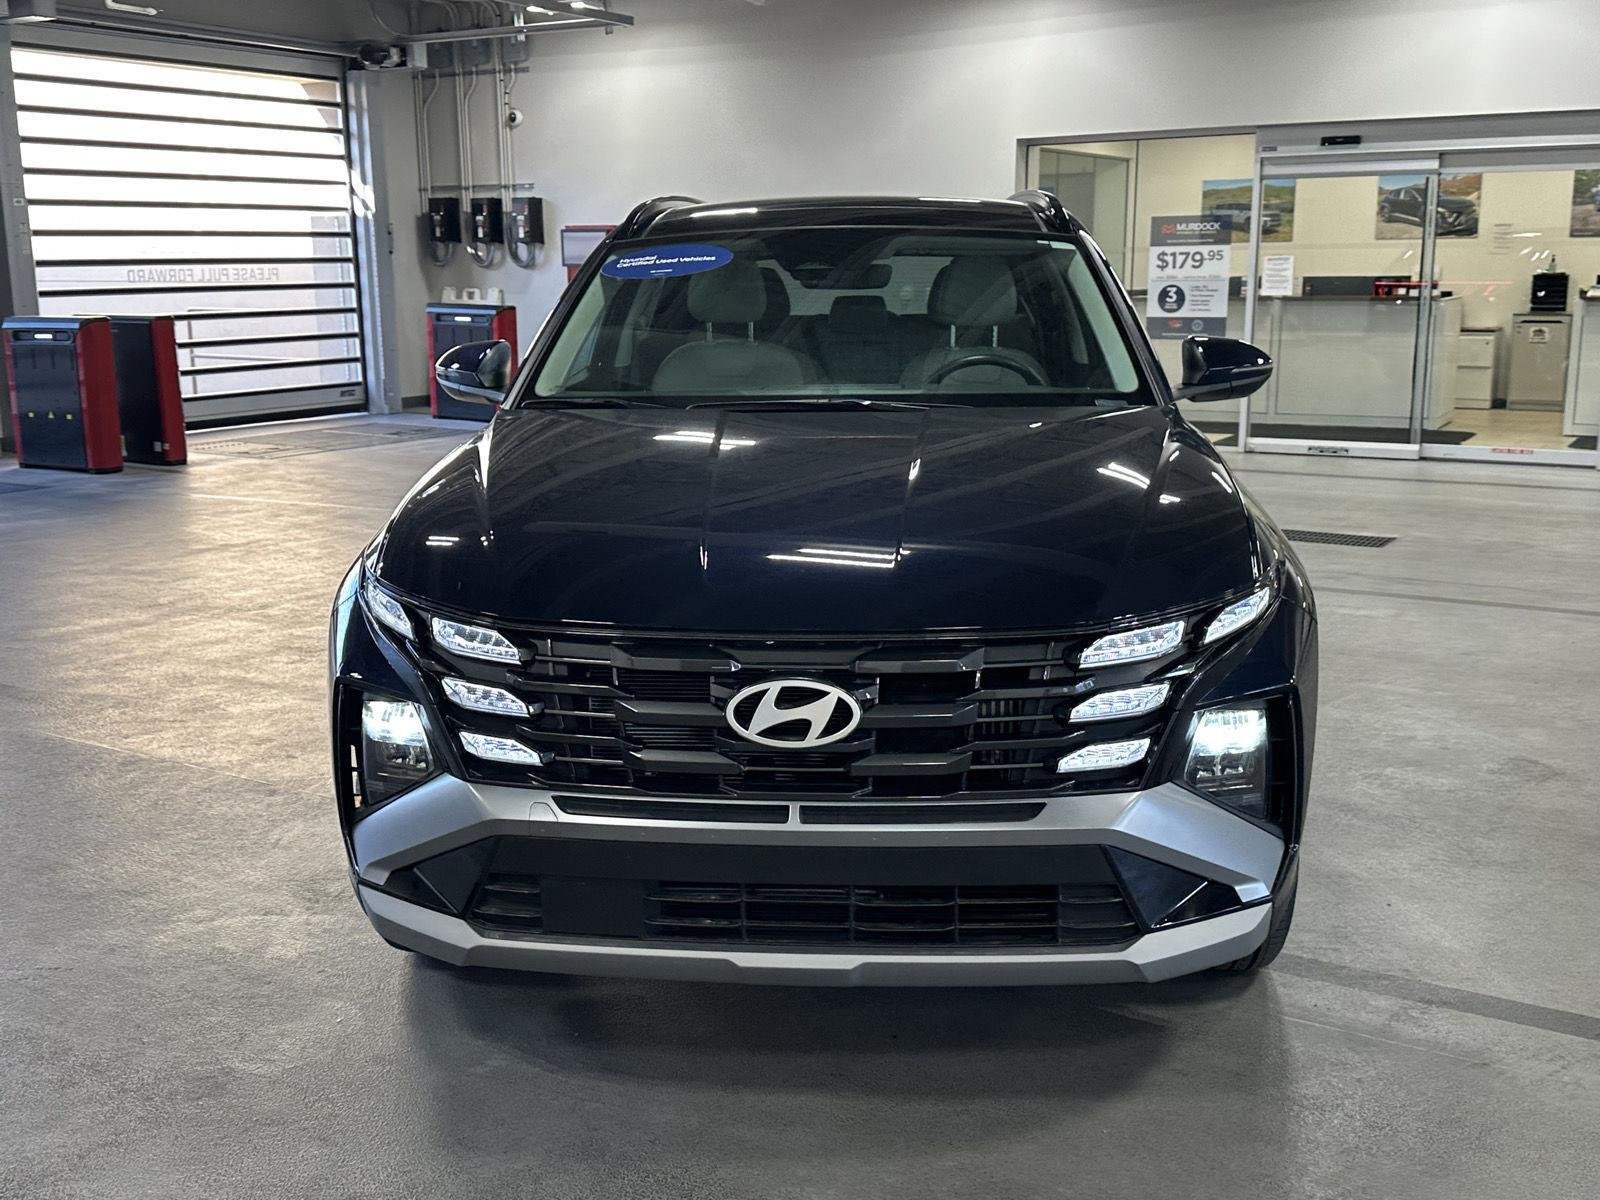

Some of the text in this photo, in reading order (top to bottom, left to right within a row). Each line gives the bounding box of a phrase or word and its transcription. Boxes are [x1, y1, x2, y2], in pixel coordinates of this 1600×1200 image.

[1176, 222, 1221, 230] MURDOCK
[617, 260, 654, 268] Certified
[680, 255, 716, 263] Vehicles
[619, 255, 657, 264] Hyundai
[1165, 287, 1178, 302] 3
